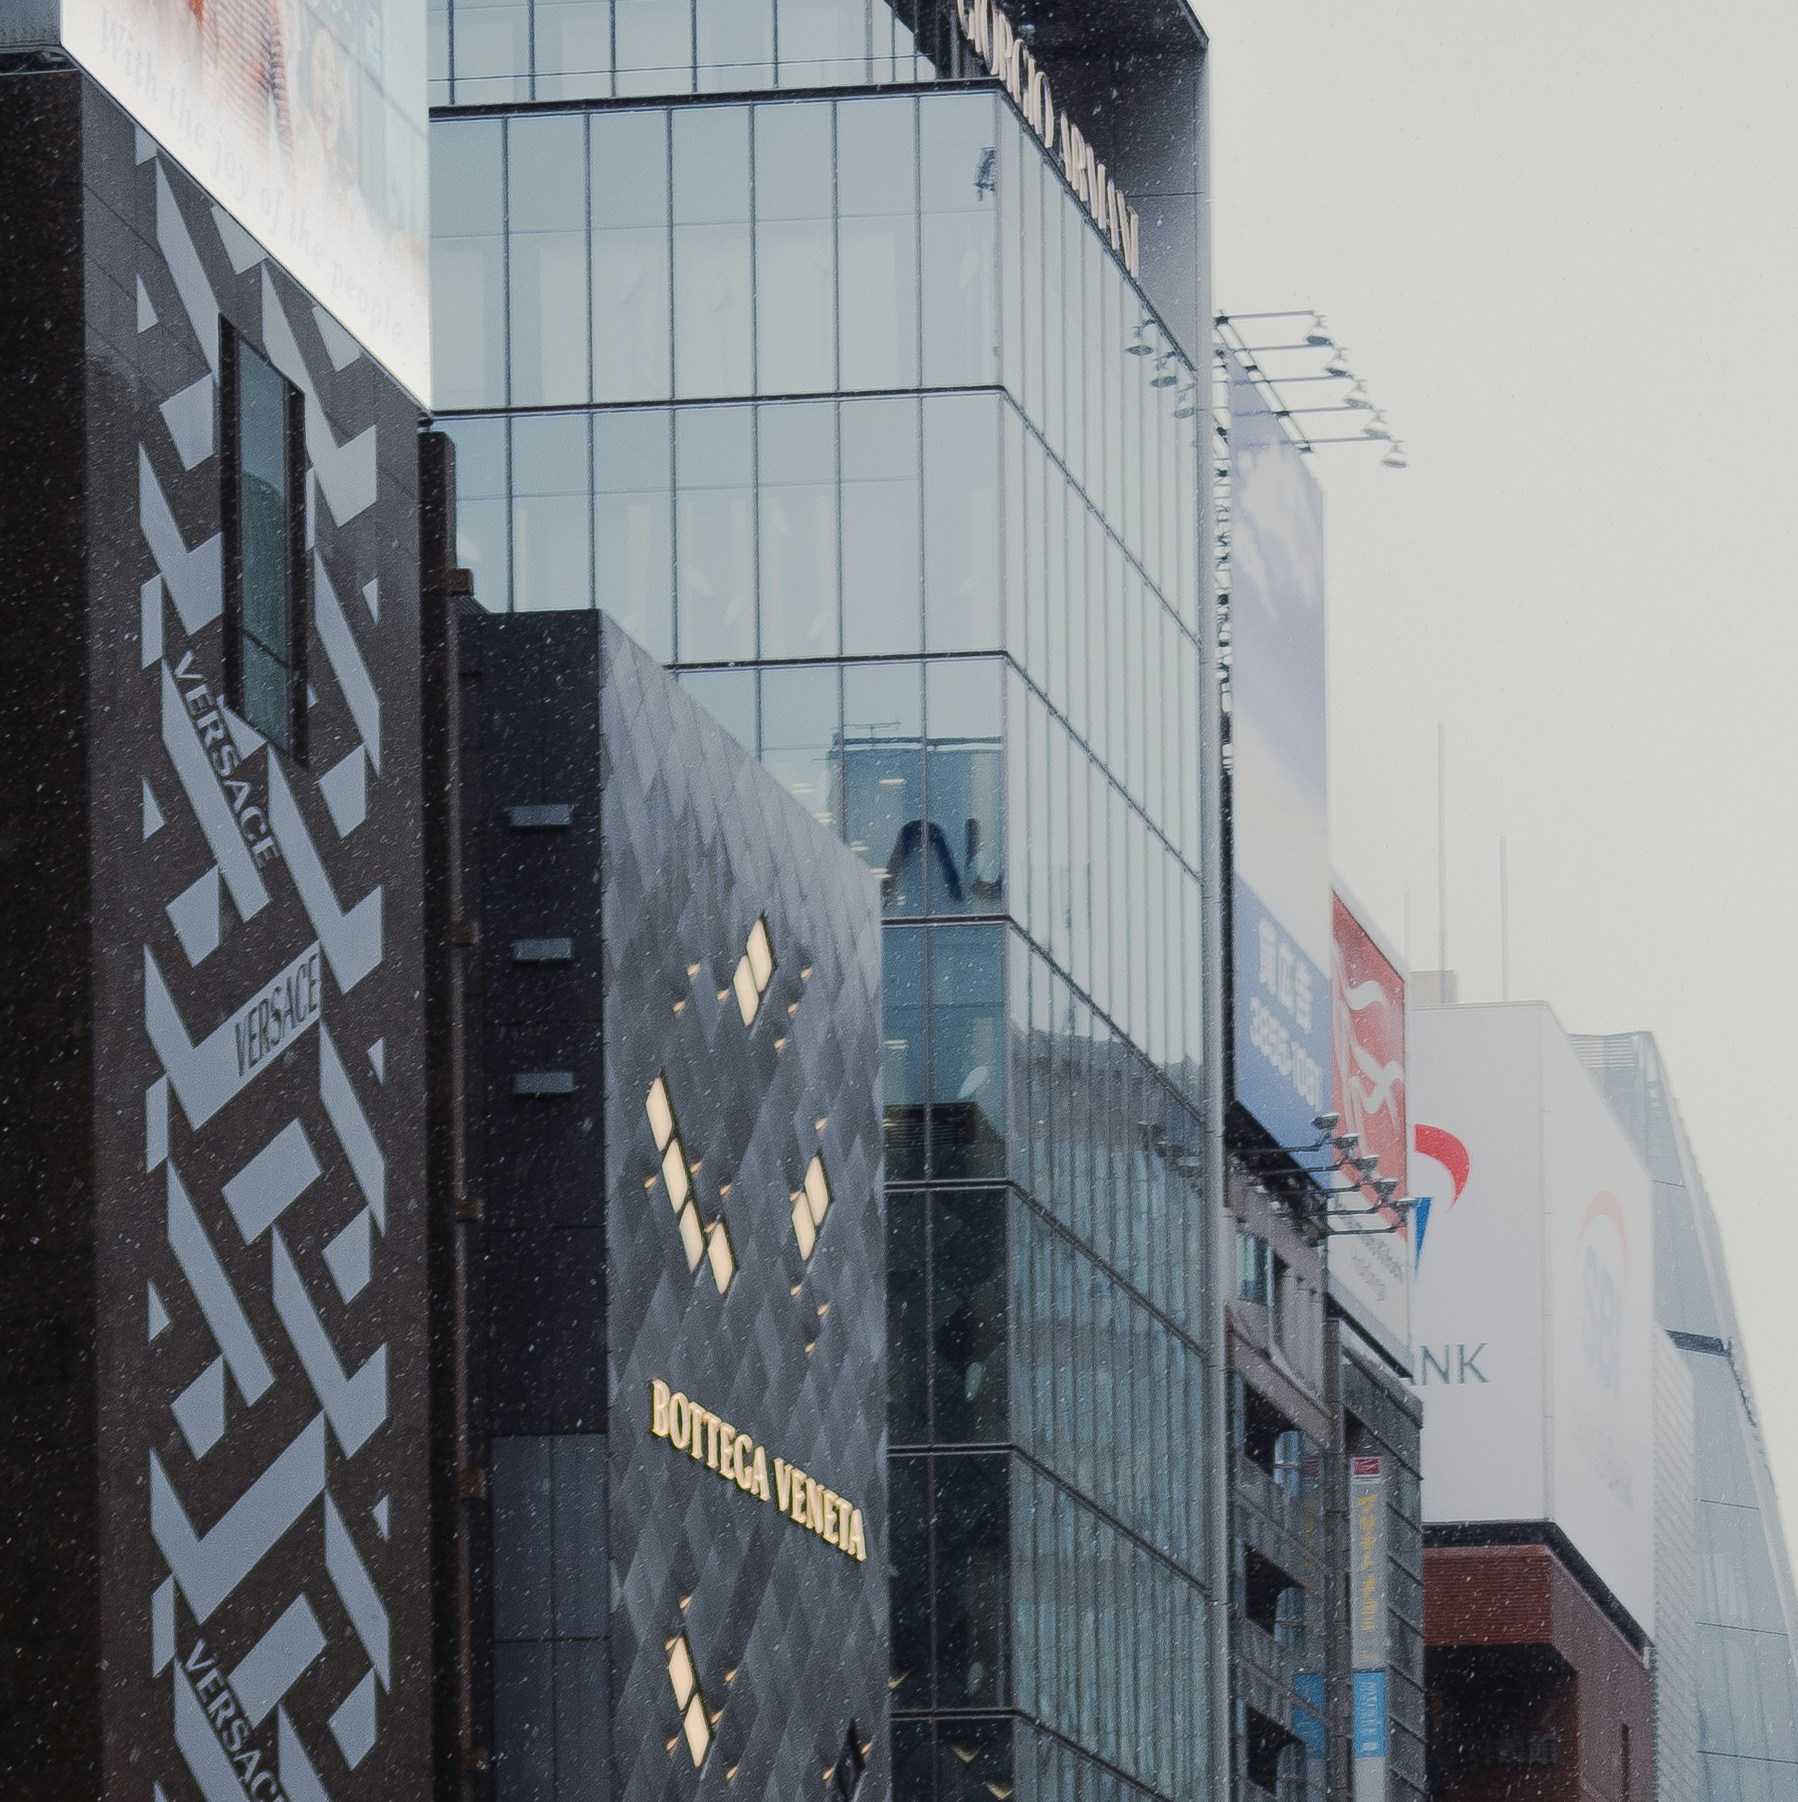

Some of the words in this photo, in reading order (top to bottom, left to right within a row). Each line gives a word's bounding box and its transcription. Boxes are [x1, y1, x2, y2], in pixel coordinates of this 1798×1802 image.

[1060, 110, 1139, 279] ARMANI
[174, 650, 281, 868] VERSACE
[235, 953, 319, 1078] VERSACE
[1409, 1342, 1489, 1386] NK
[652, 1378, 771, 1502] BOTTEGA
[774, 1457, 867, 1562] VENETA
